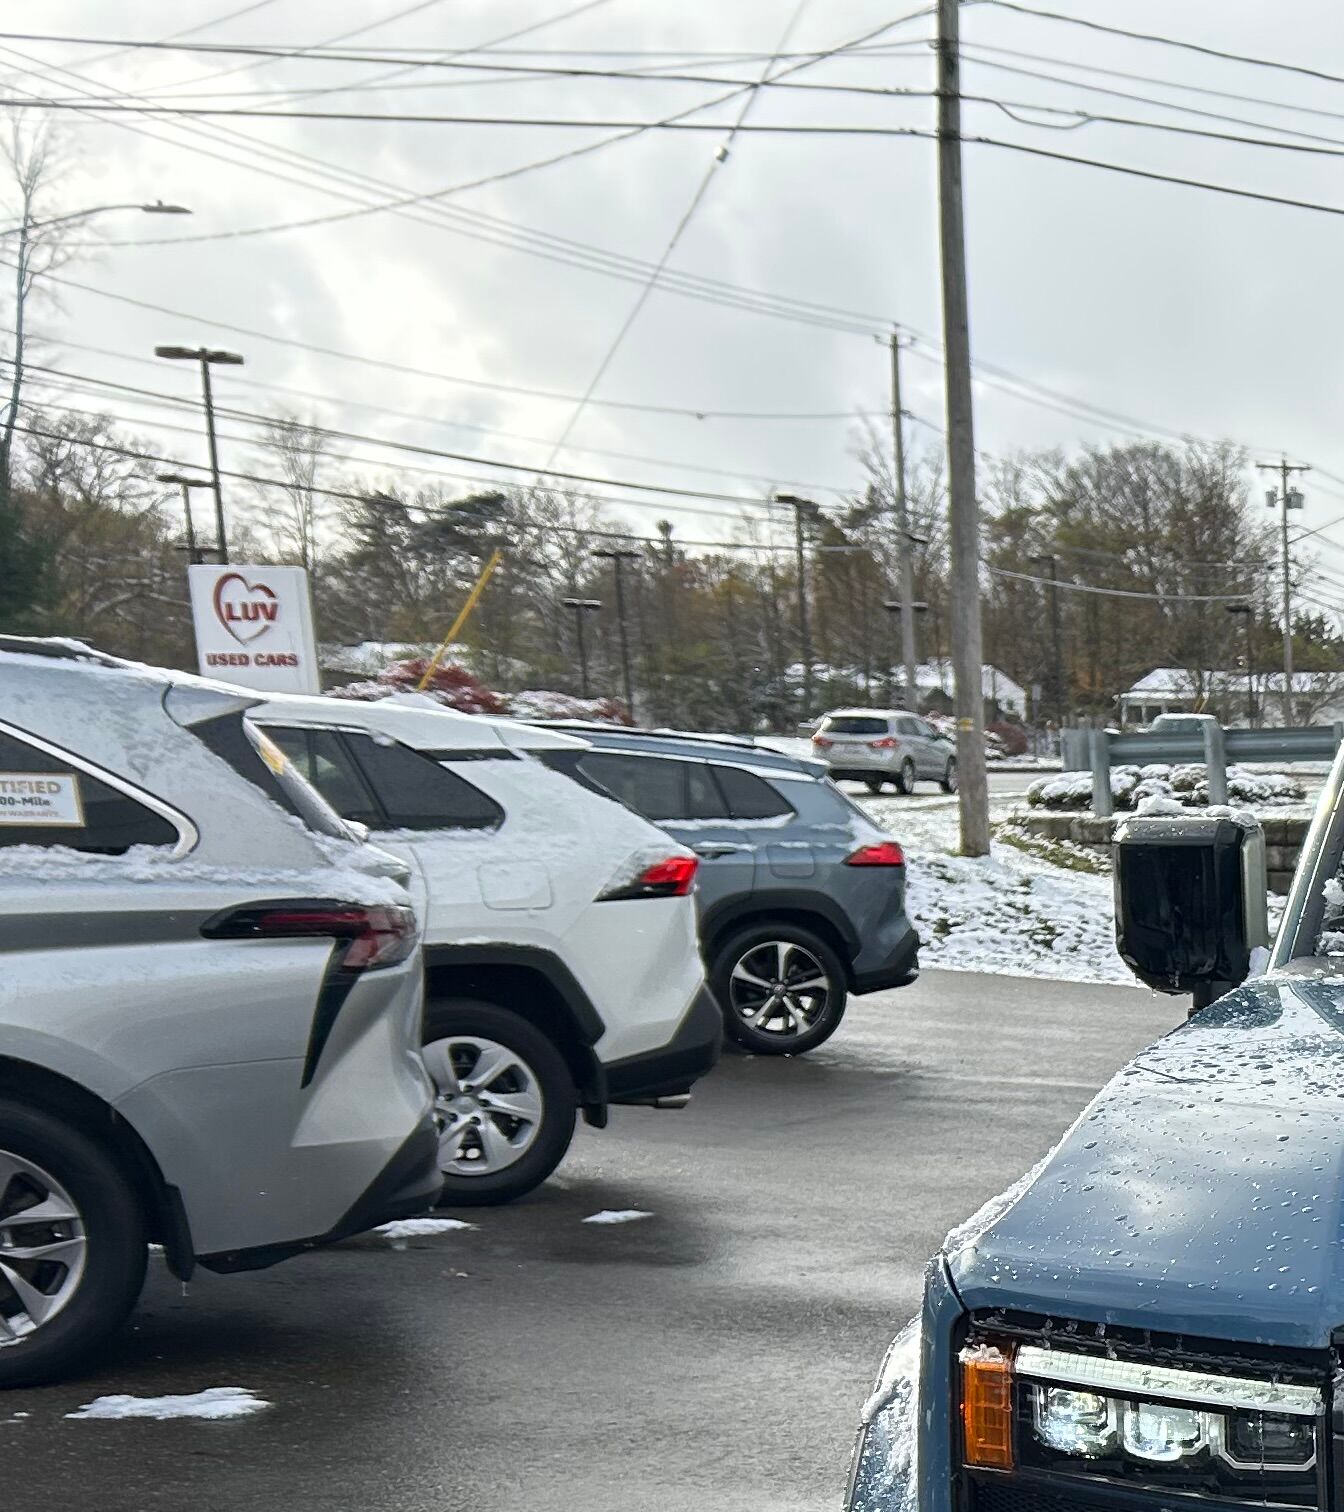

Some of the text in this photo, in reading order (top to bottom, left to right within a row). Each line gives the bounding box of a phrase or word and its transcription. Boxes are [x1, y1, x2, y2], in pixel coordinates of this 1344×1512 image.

[225, 602, 278, 621] LUV
[206, 653, 299, 667] USED CARS
